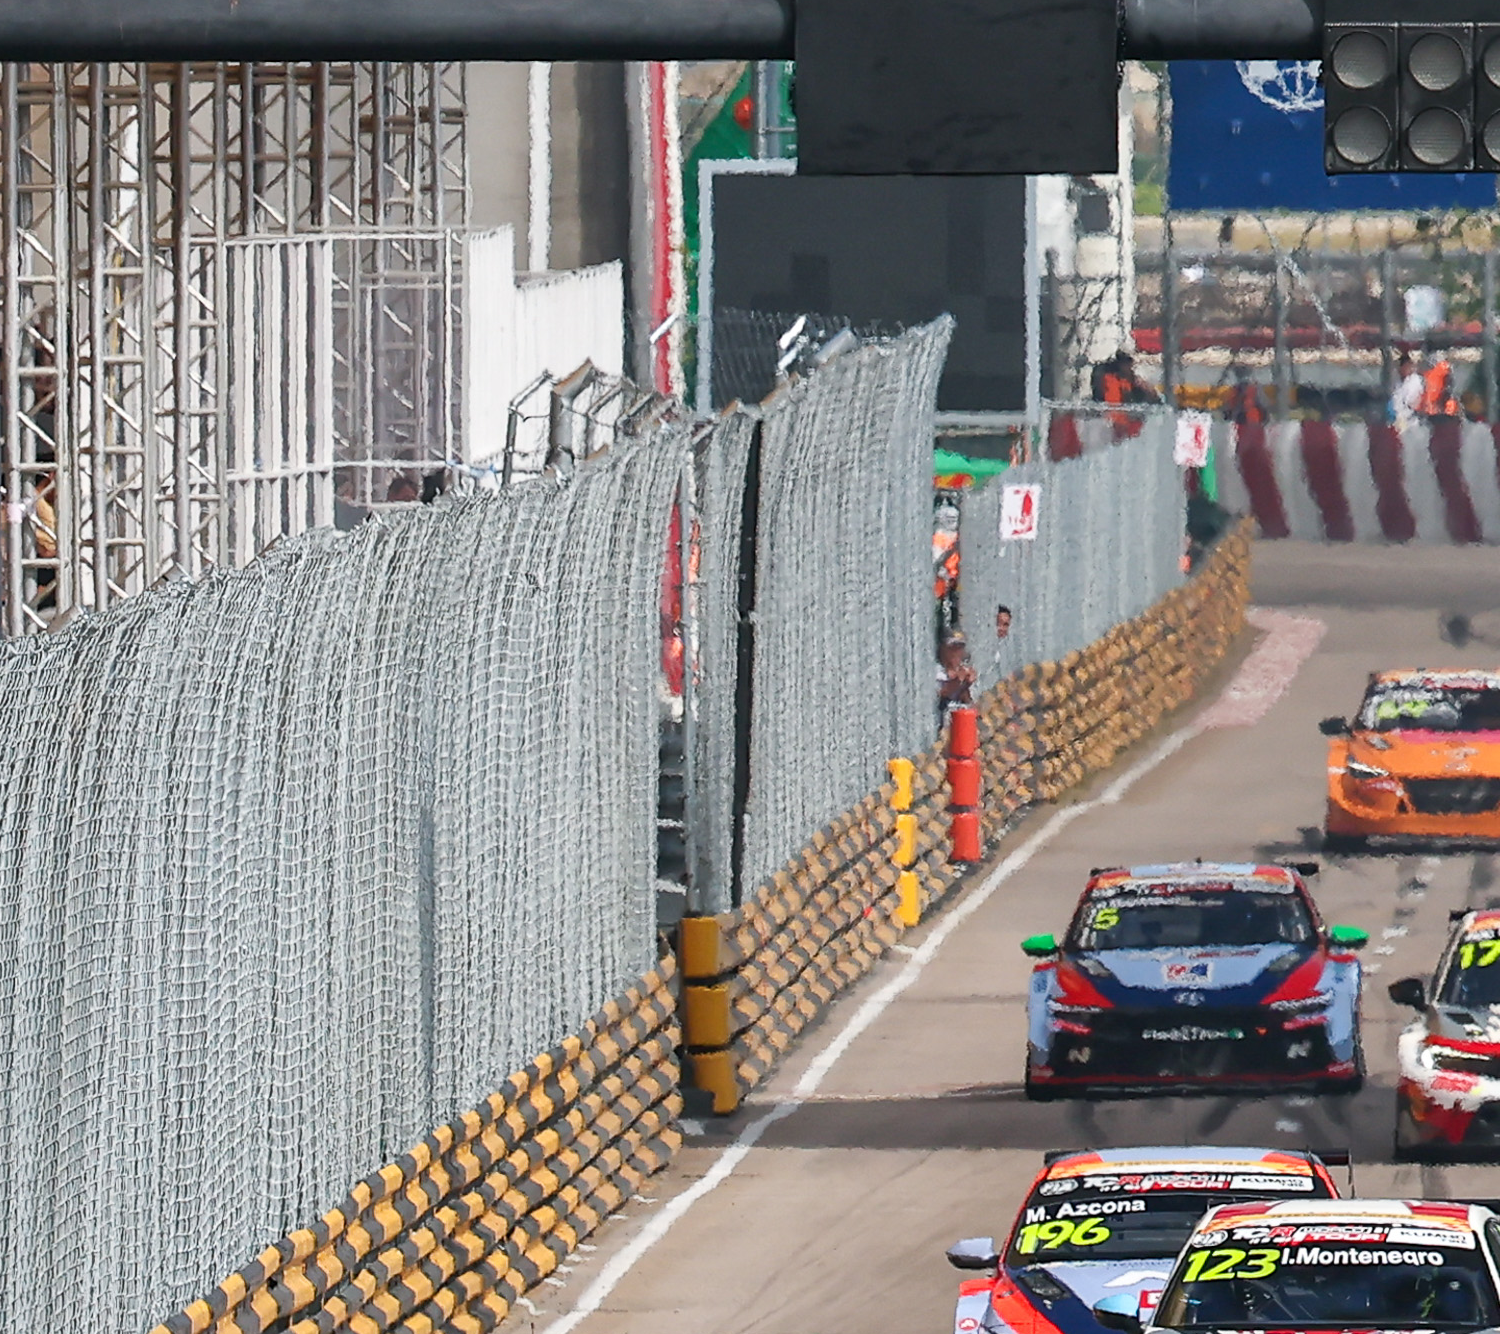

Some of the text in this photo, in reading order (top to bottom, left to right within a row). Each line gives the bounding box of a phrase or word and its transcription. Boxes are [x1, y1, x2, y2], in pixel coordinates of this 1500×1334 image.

[1092, 907, 1120, 931] 5
[1026, 1198, 1146, 1224] M. Azcona
[1018, 1218, 1110, 1255] 196
[1181, 1247, 1280, 1283] 123
